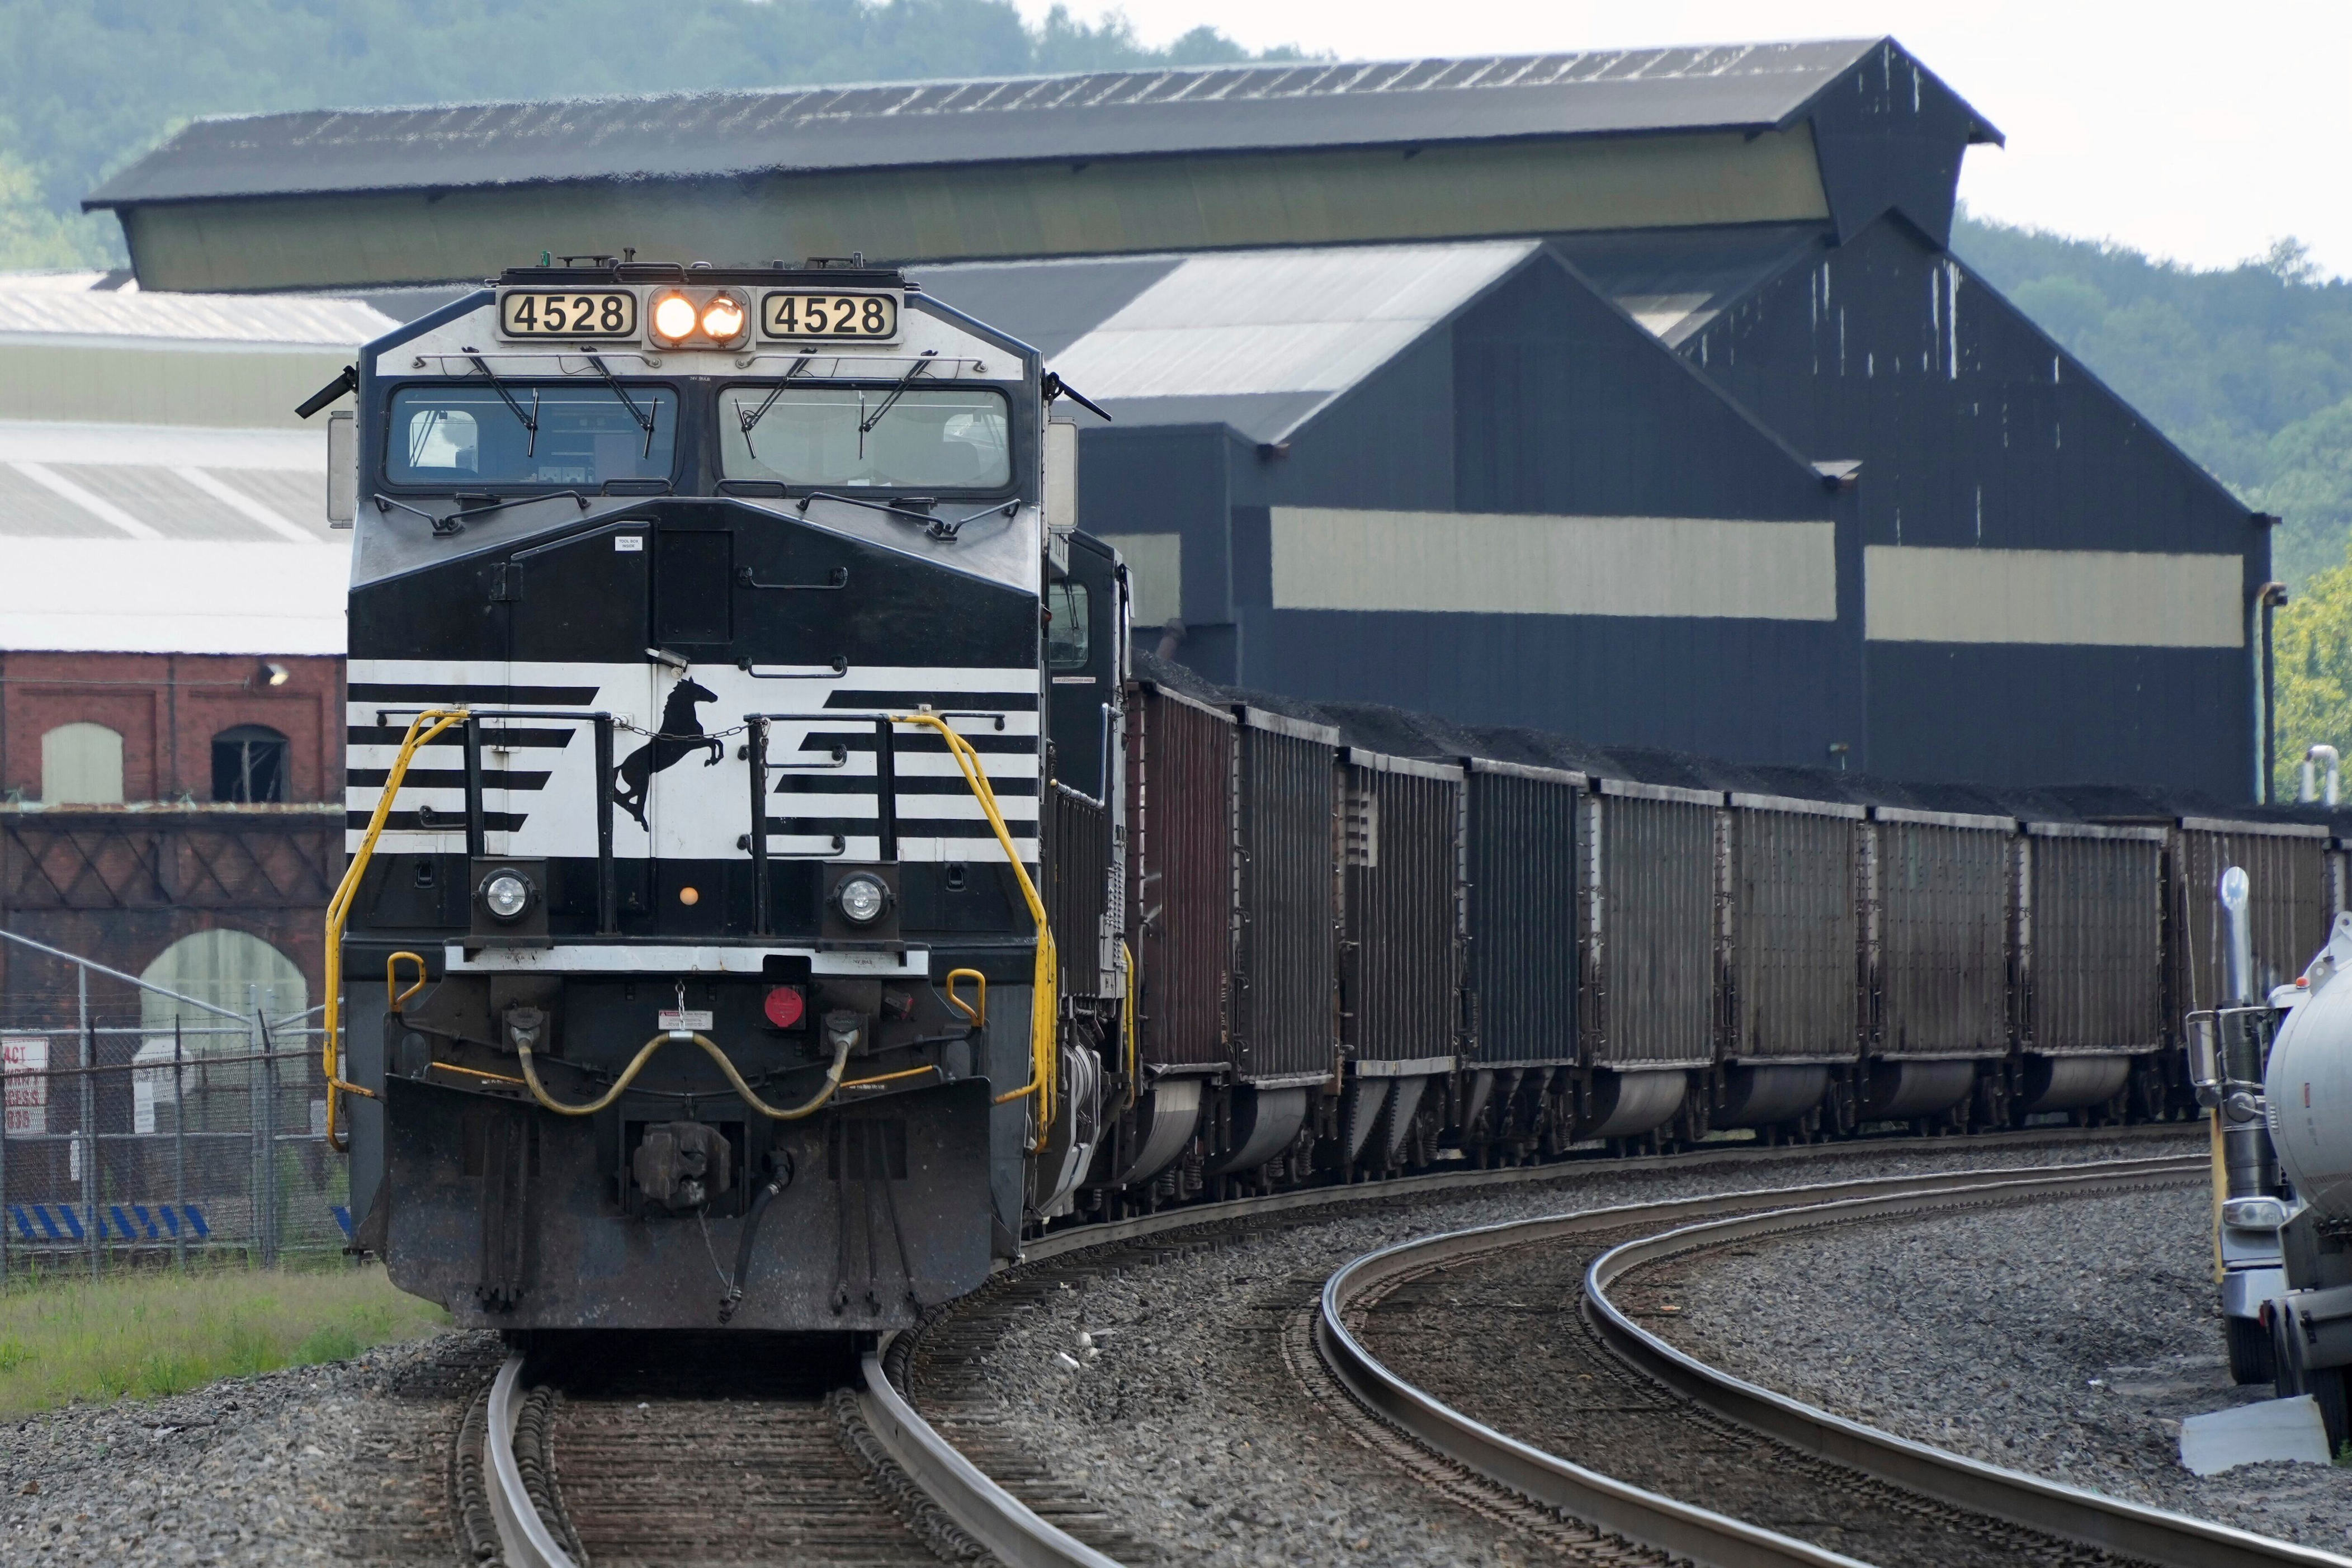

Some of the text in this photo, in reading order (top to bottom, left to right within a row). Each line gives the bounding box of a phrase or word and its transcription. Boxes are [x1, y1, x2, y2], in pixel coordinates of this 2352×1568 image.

[514, 296, 624, 331] 4528
[774, 297, 885, 333] 4528
[4, 1090, 39, 1107] CESS
